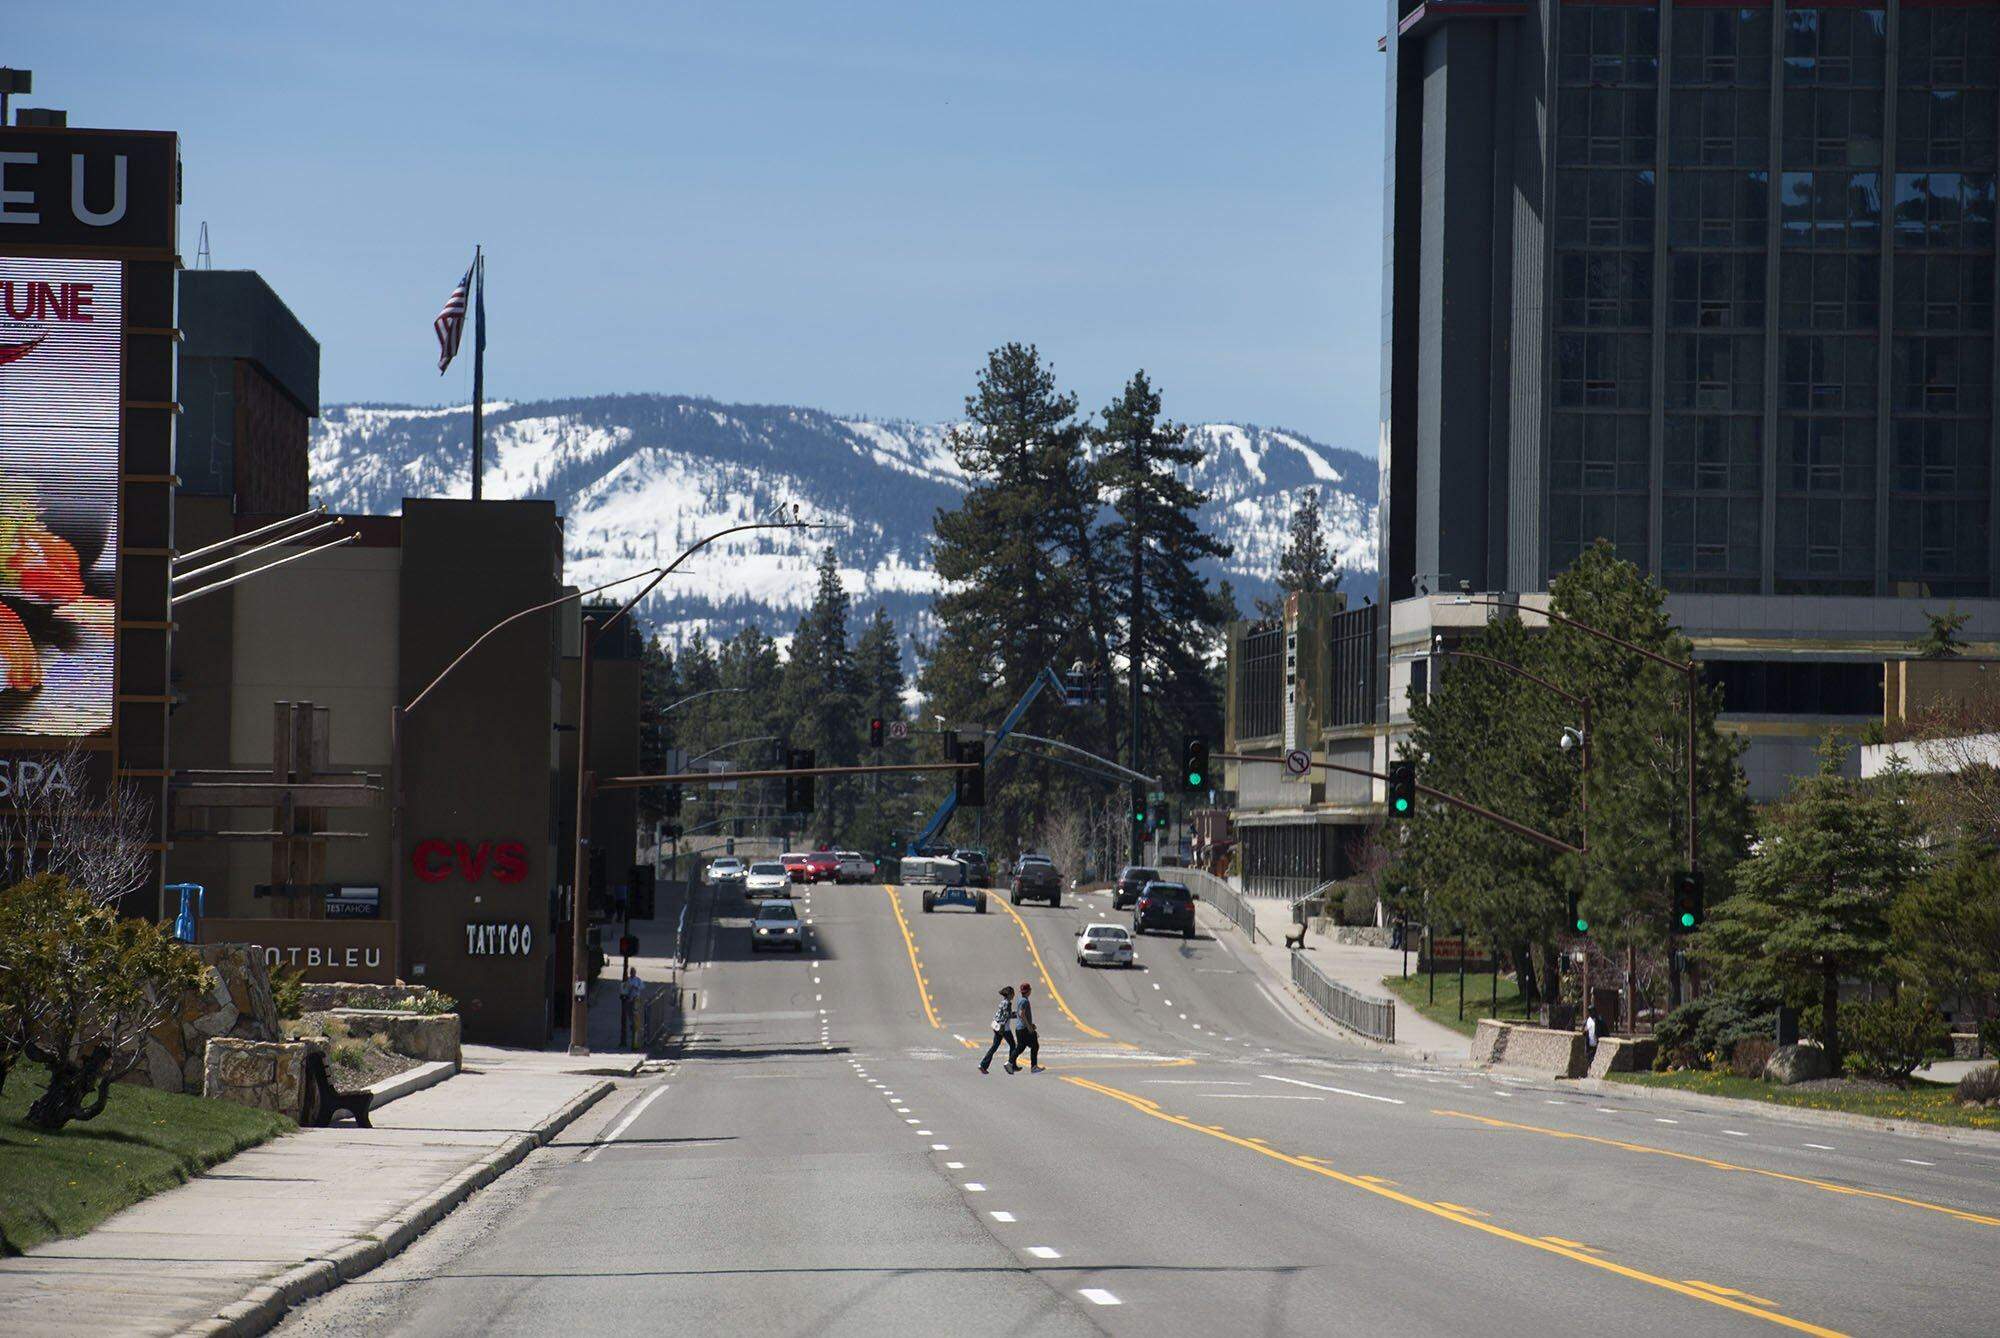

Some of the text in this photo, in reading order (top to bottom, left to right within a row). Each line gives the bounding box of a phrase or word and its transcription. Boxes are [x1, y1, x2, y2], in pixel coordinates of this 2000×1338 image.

[0, 152, 128, 227] EU
[0, 281, 94, 323] UNE
[412, 838, 529, 884] CVS
[466, 923, 532, 956] TATTOO
